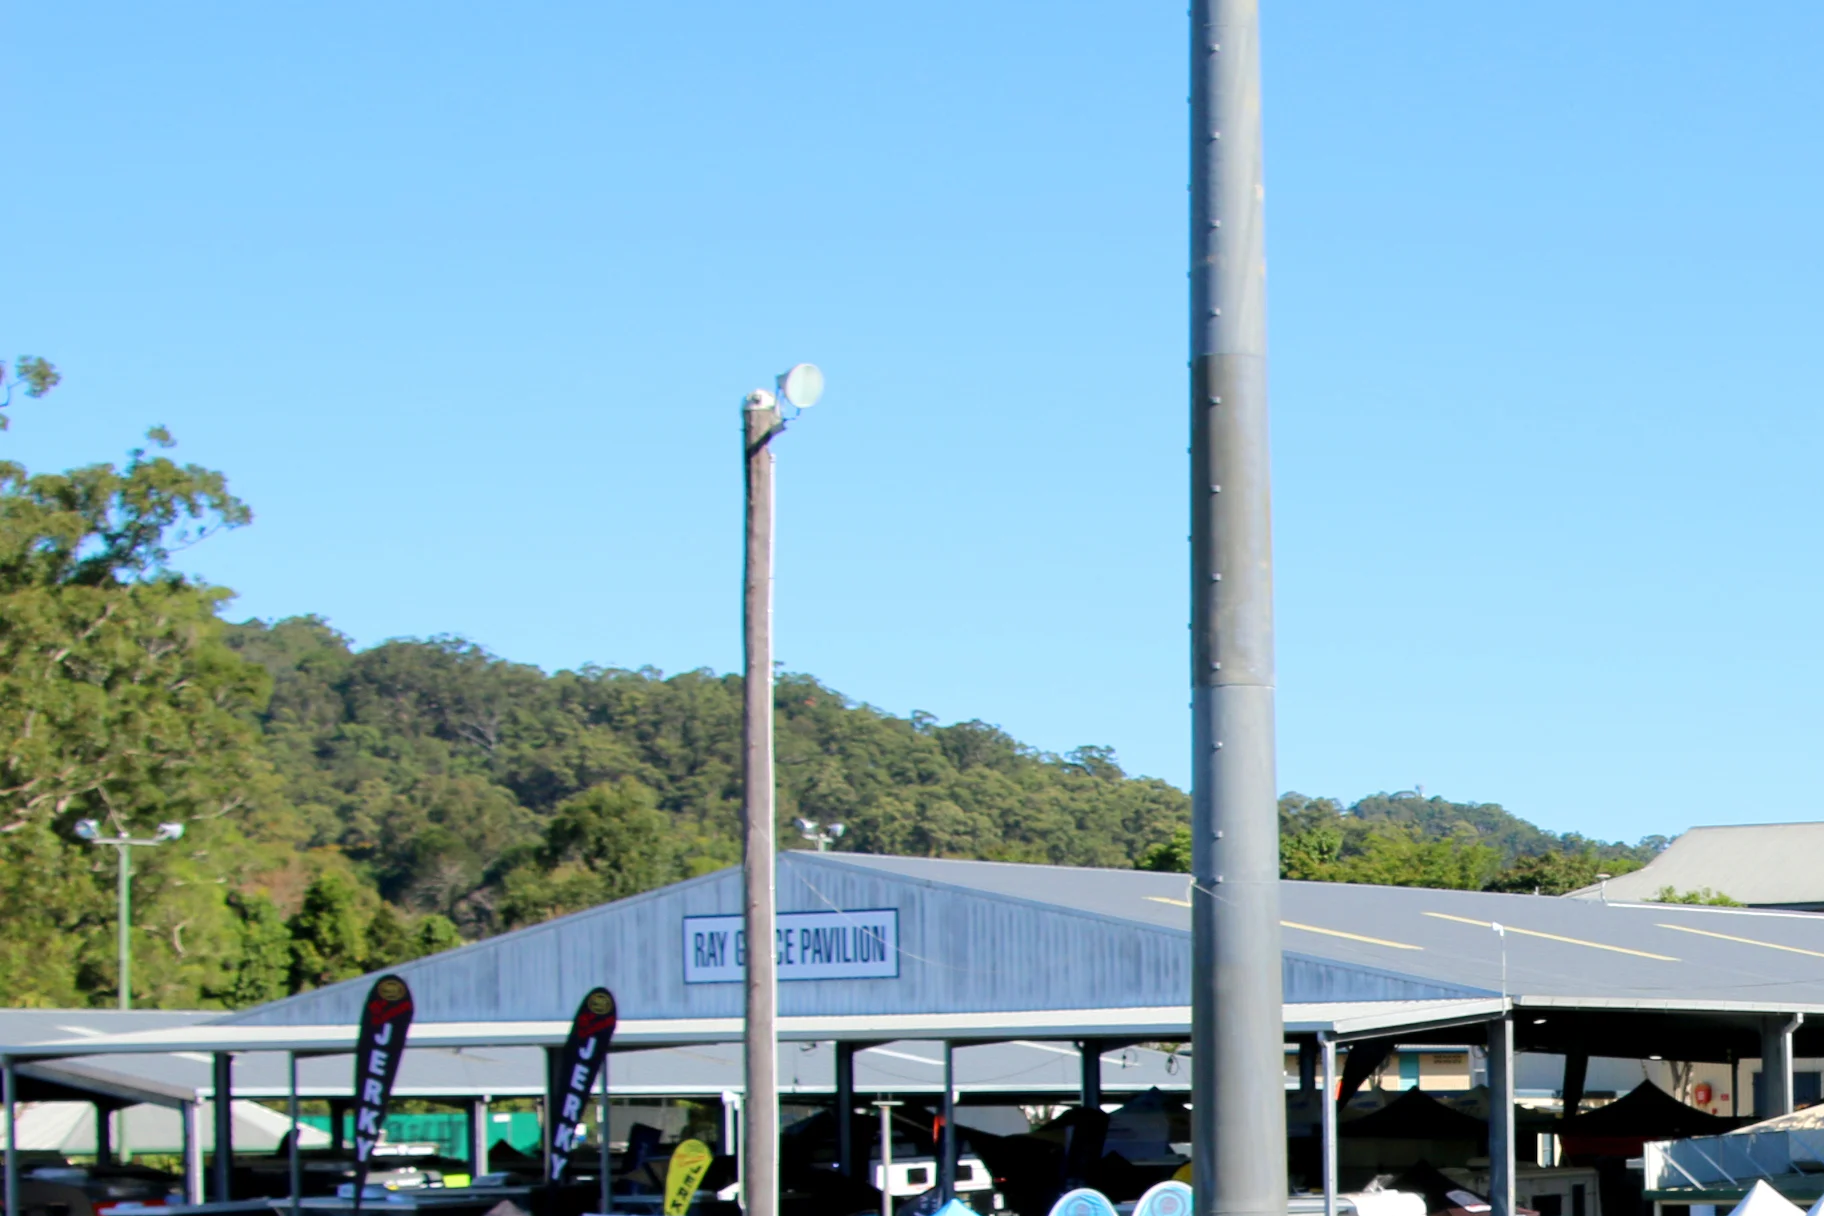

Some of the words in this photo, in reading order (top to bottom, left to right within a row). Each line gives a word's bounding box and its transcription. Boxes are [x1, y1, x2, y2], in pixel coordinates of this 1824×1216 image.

[694, 931, 727, 967] RAY
[801, 926, 885, 964] PAVILION
[357, 1023, 392, 1161] JERKY
[552, 1036, 596, 1179] JERKY
[671, 1165, 703, 1210] JERK
